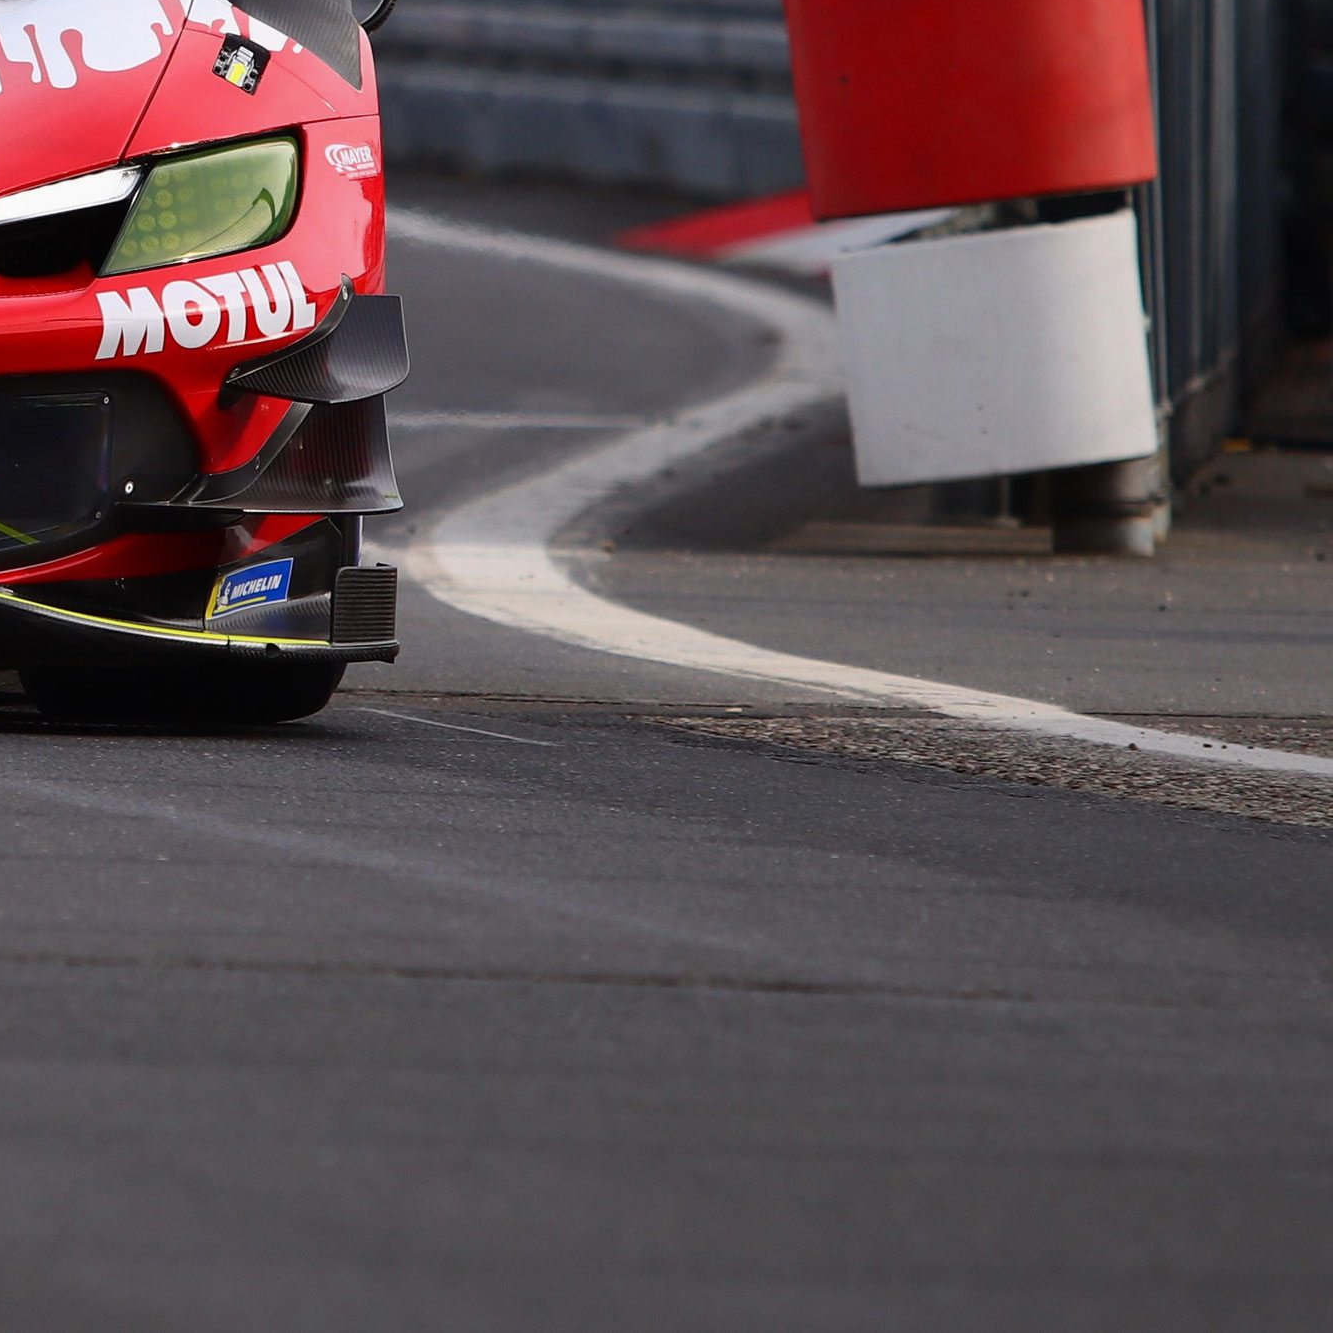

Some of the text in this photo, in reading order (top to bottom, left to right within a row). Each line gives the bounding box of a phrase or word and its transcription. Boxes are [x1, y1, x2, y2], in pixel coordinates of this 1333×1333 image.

[339, 146, 374, 166] MAYER
[95, 260, 318, 360] MOTUL
[230, 574, 283, 601] MICHELIN
